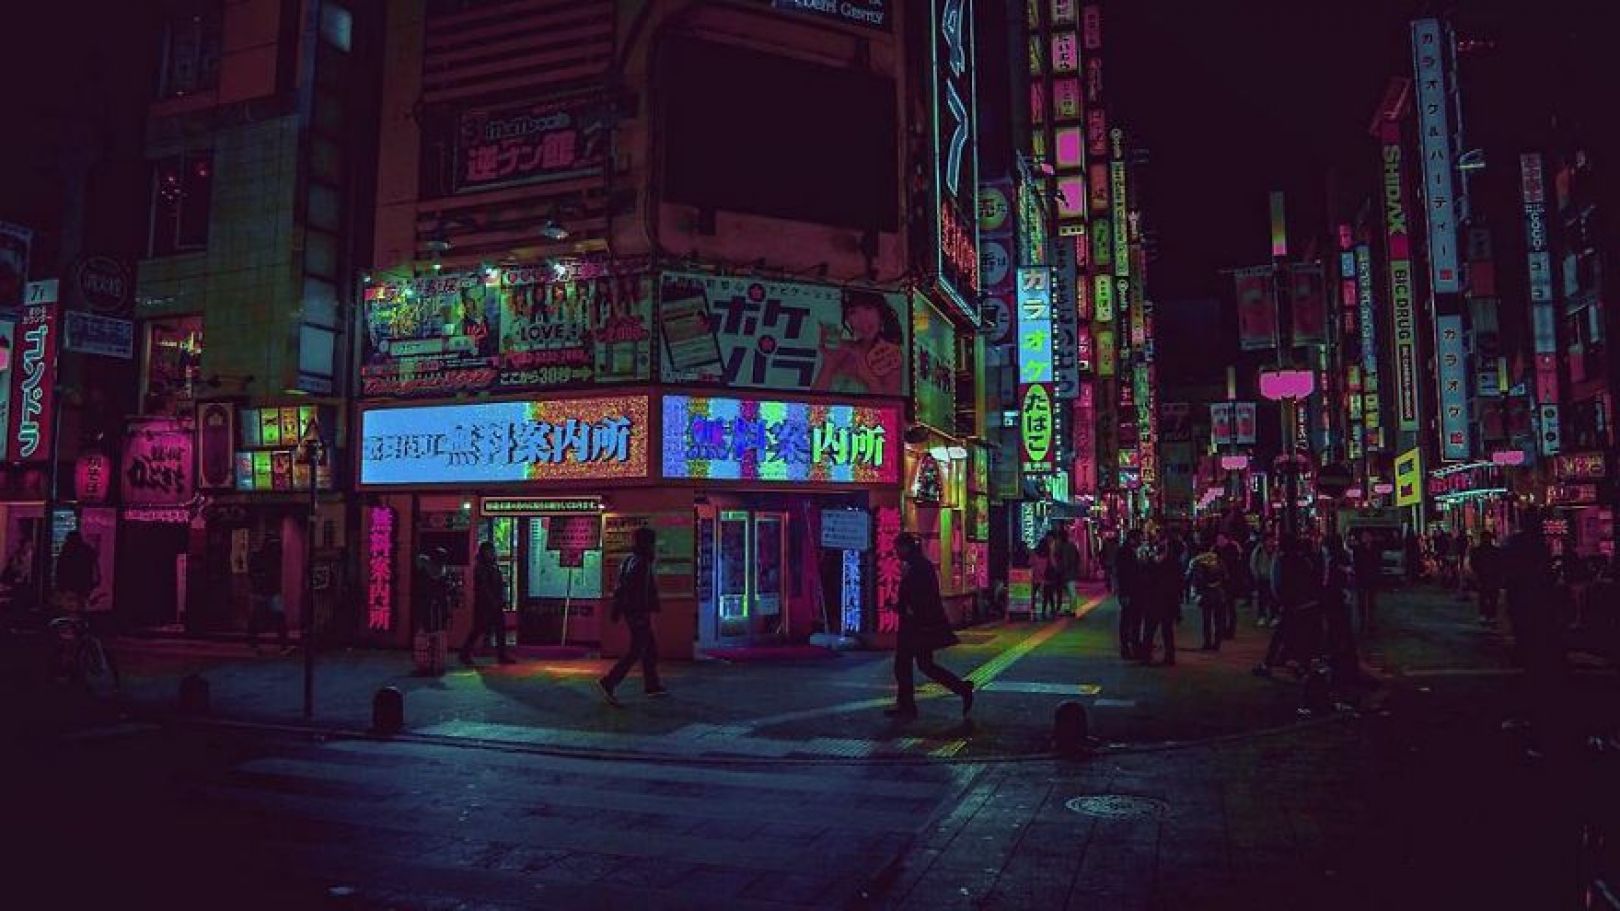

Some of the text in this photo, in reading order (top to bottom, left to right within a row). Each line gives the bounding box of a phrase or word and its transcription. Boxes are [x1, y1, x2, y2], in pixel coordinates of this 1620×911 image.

[1383, 145, 1406, 234] SHIDAX
[711, 283, 812, 339] ポケ
[1023, 271, 1050, 380] カラオケ
[1396, 297, 1410, 340] DRUG
[726, 331, 817, 386] パラ
[19, 324, 48, 458] ゴンドラ
[687, 417, 885, 466] 無料案内所
